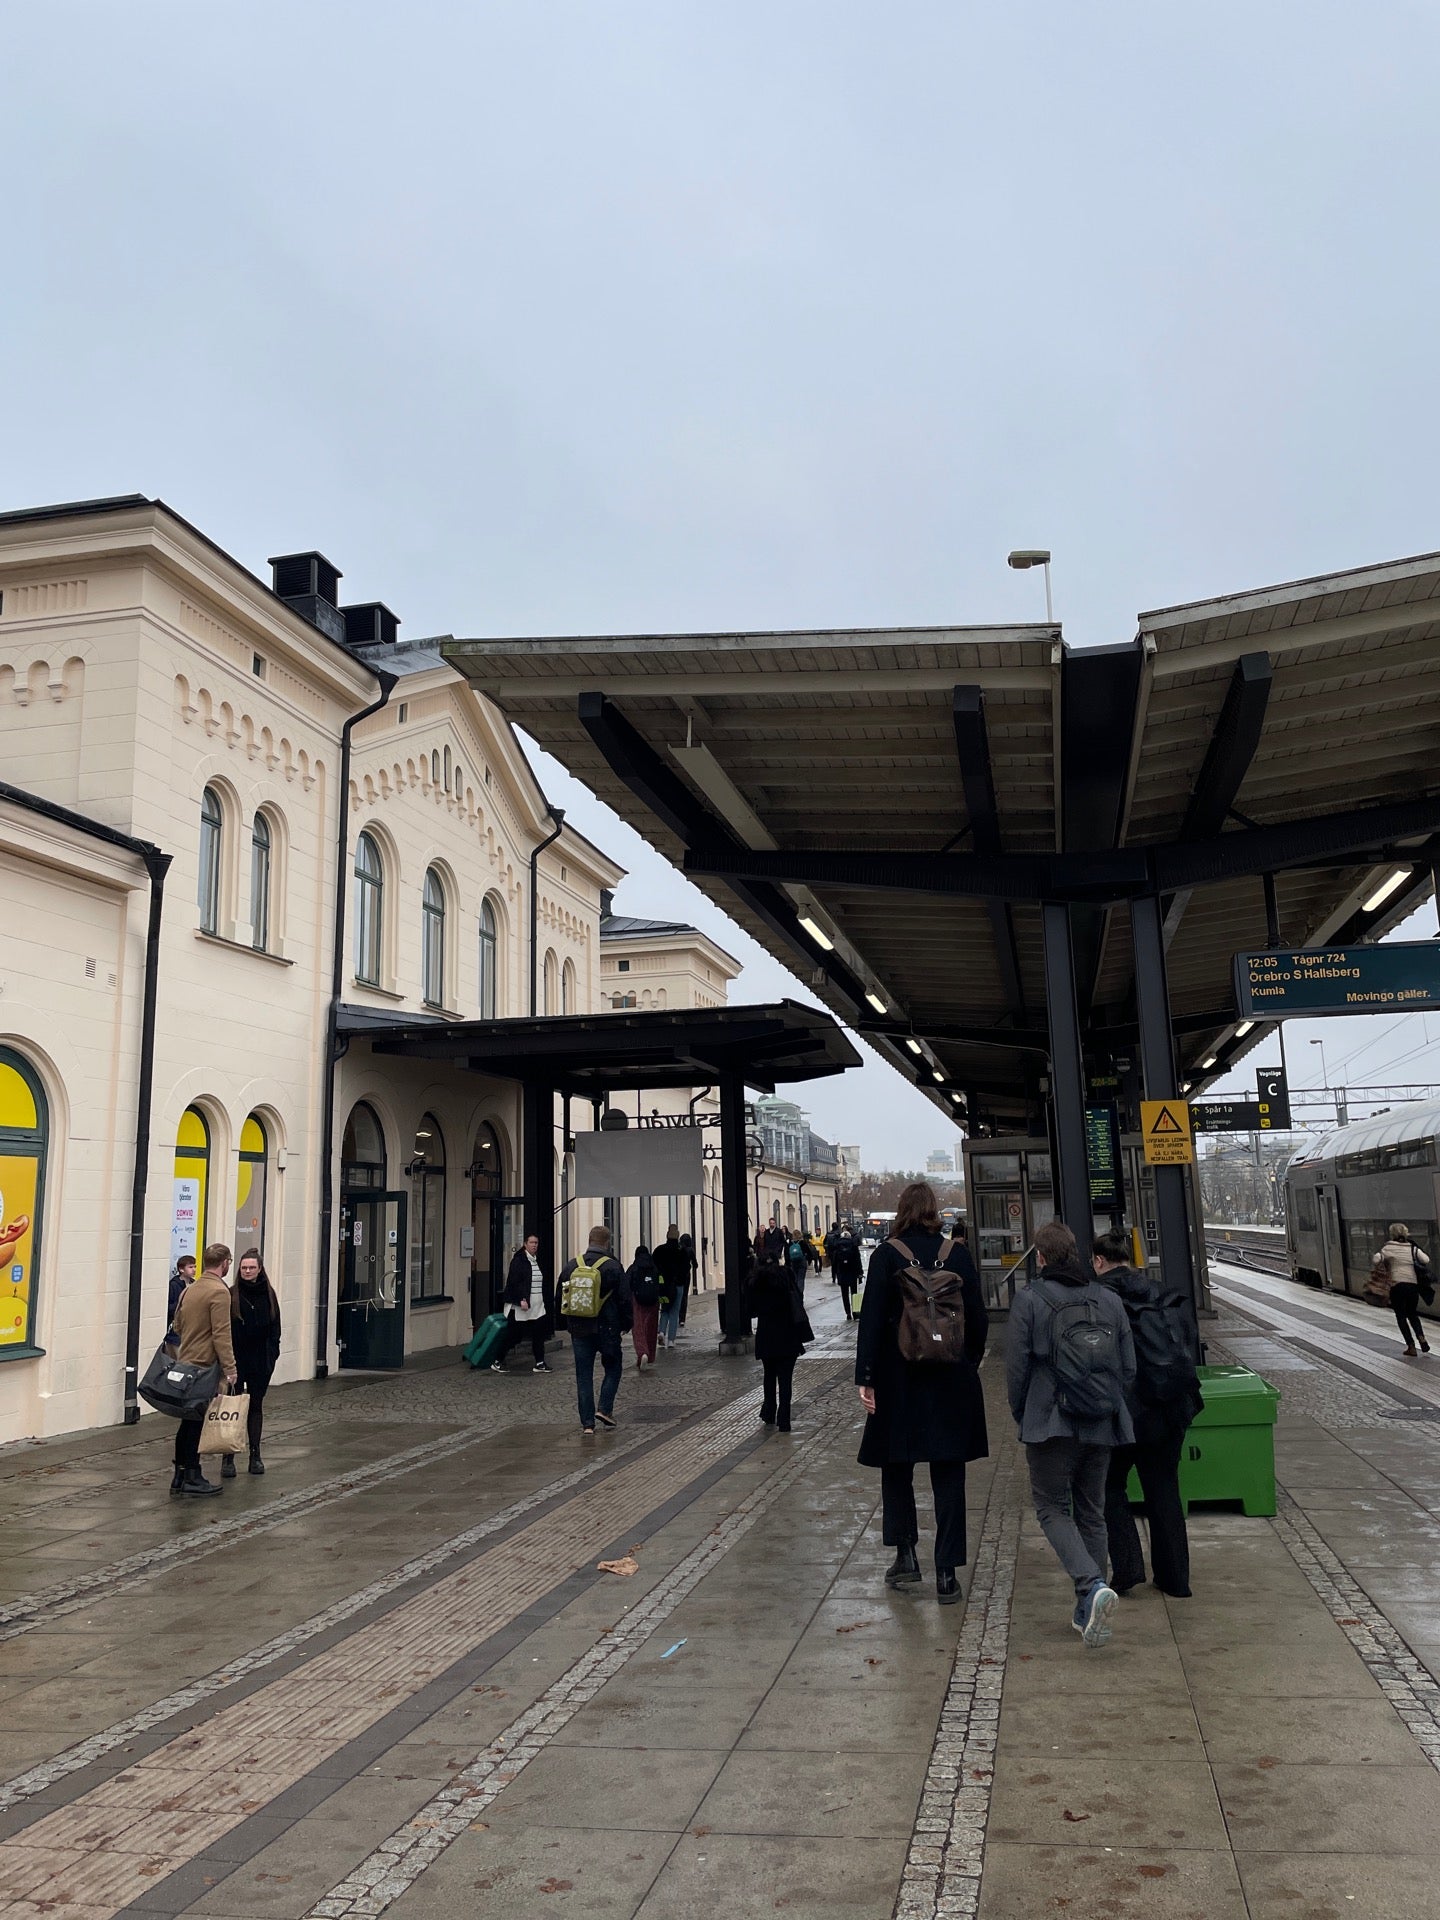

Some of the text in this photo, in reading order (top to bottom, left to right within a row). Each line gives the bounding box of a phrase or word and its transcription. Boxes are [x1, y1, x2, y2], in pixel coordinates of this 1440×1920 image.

[1248, 953, 1346, 968] 12:05 Tågnr 724
[1249, 967, 1360, 983] Örebro S Hallsberg
[1251, 986, 1286, 997] Kumla
[1346, 989, 1431, 1003] Movingo gäller.
[1267, 1083, 1278, 1096] C
[1204, 1105, 1233, 1115] Spår 1a
